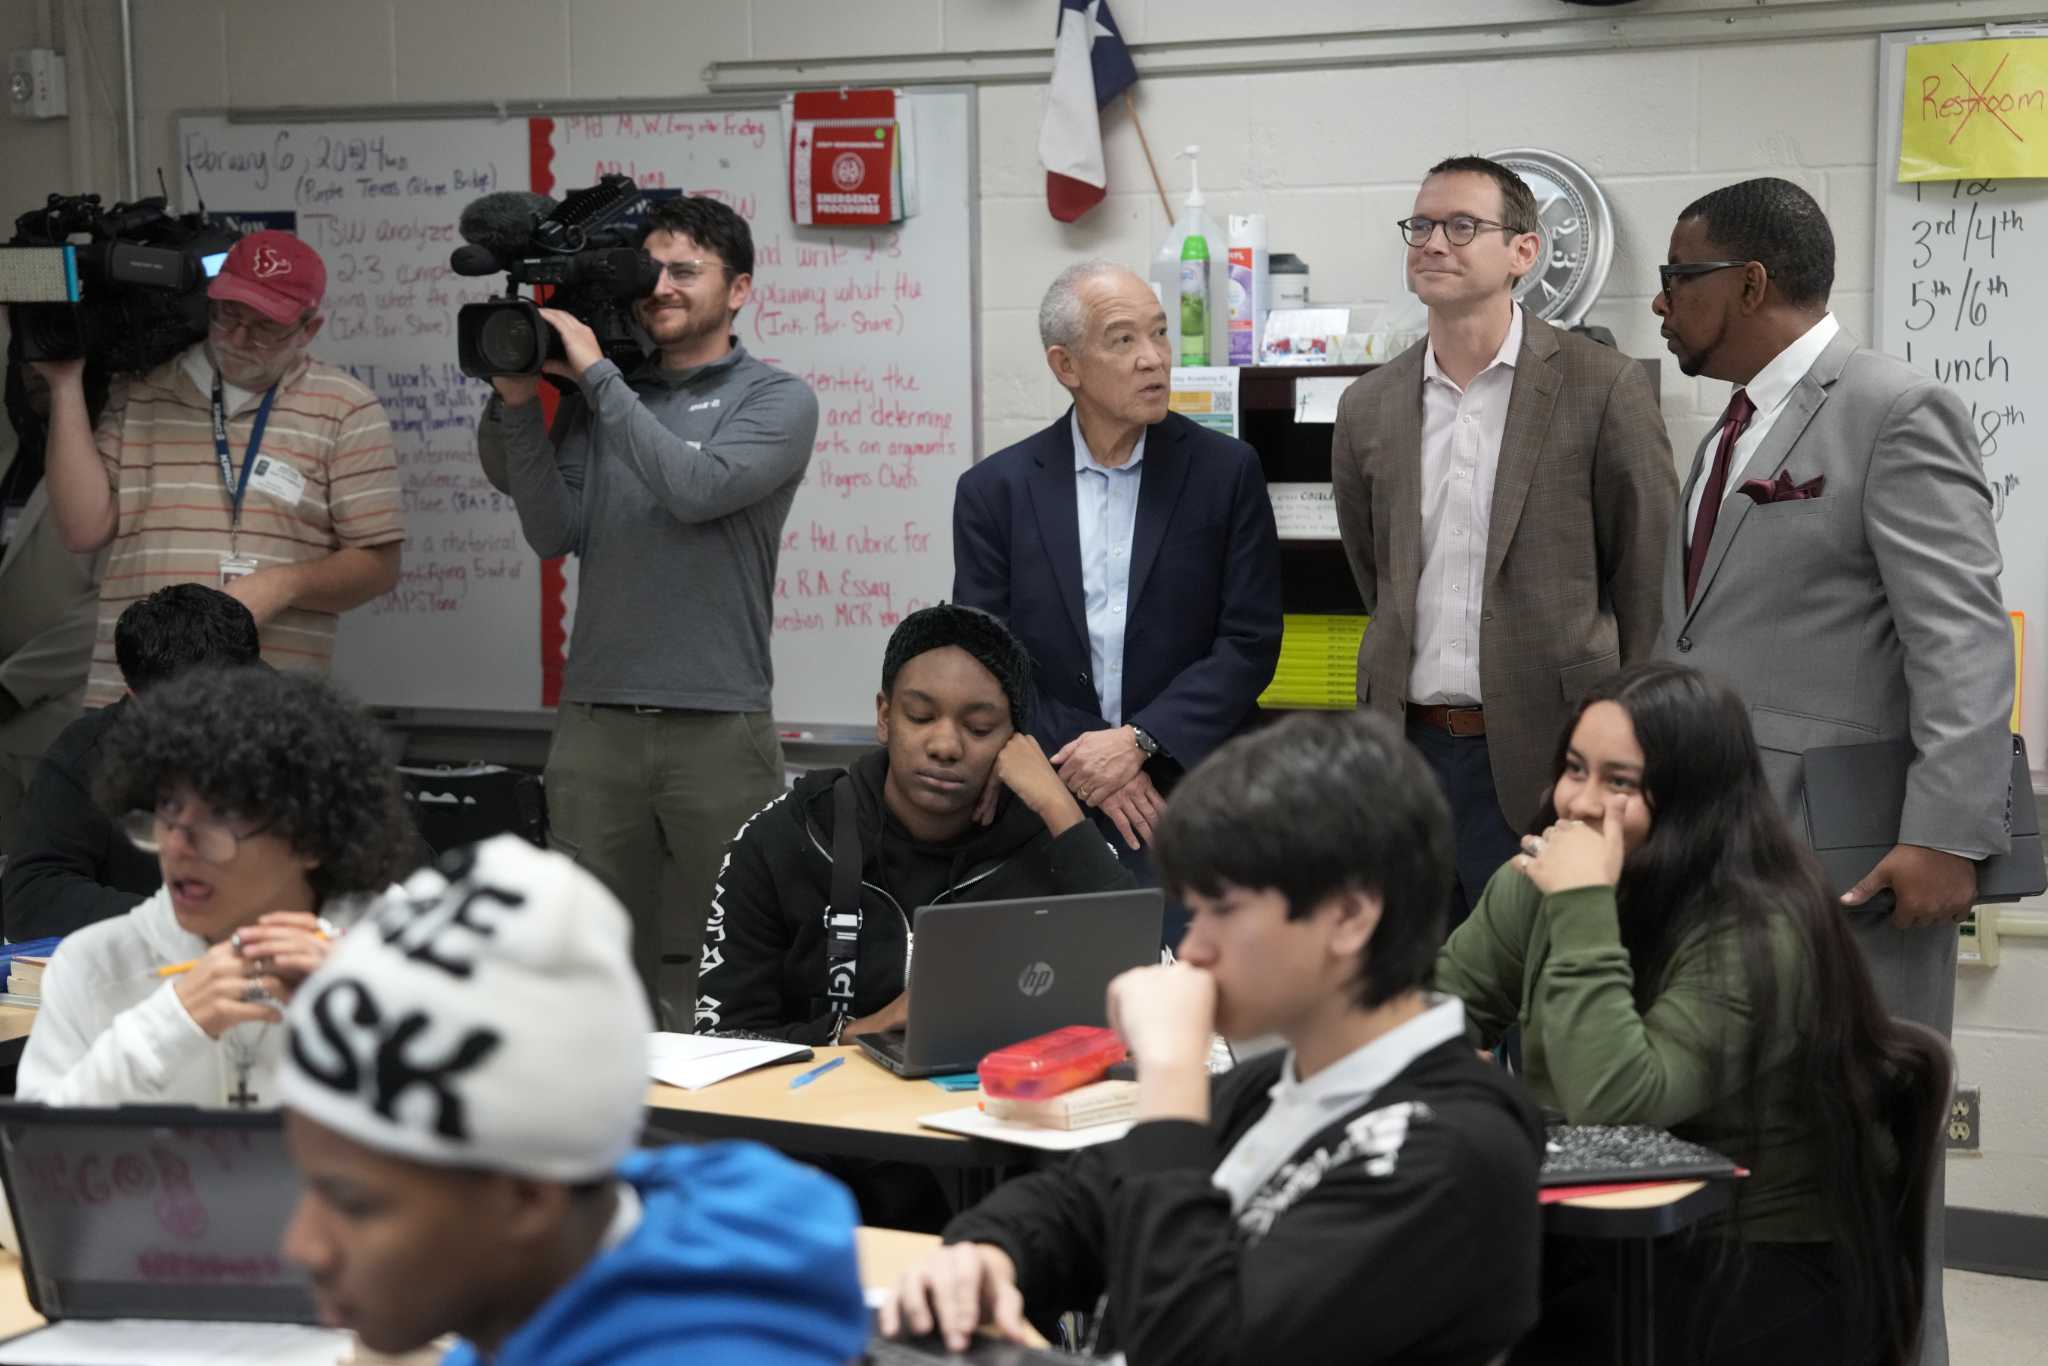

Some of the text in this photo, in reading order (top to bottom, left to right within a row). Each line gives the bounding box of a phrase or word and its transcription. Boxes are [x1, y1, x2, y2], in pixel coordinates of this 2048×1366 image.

[802, 362, 875, 404] dentify
[826, 399, 863, 428] and
[1017, 961, 1056, 998] hp
